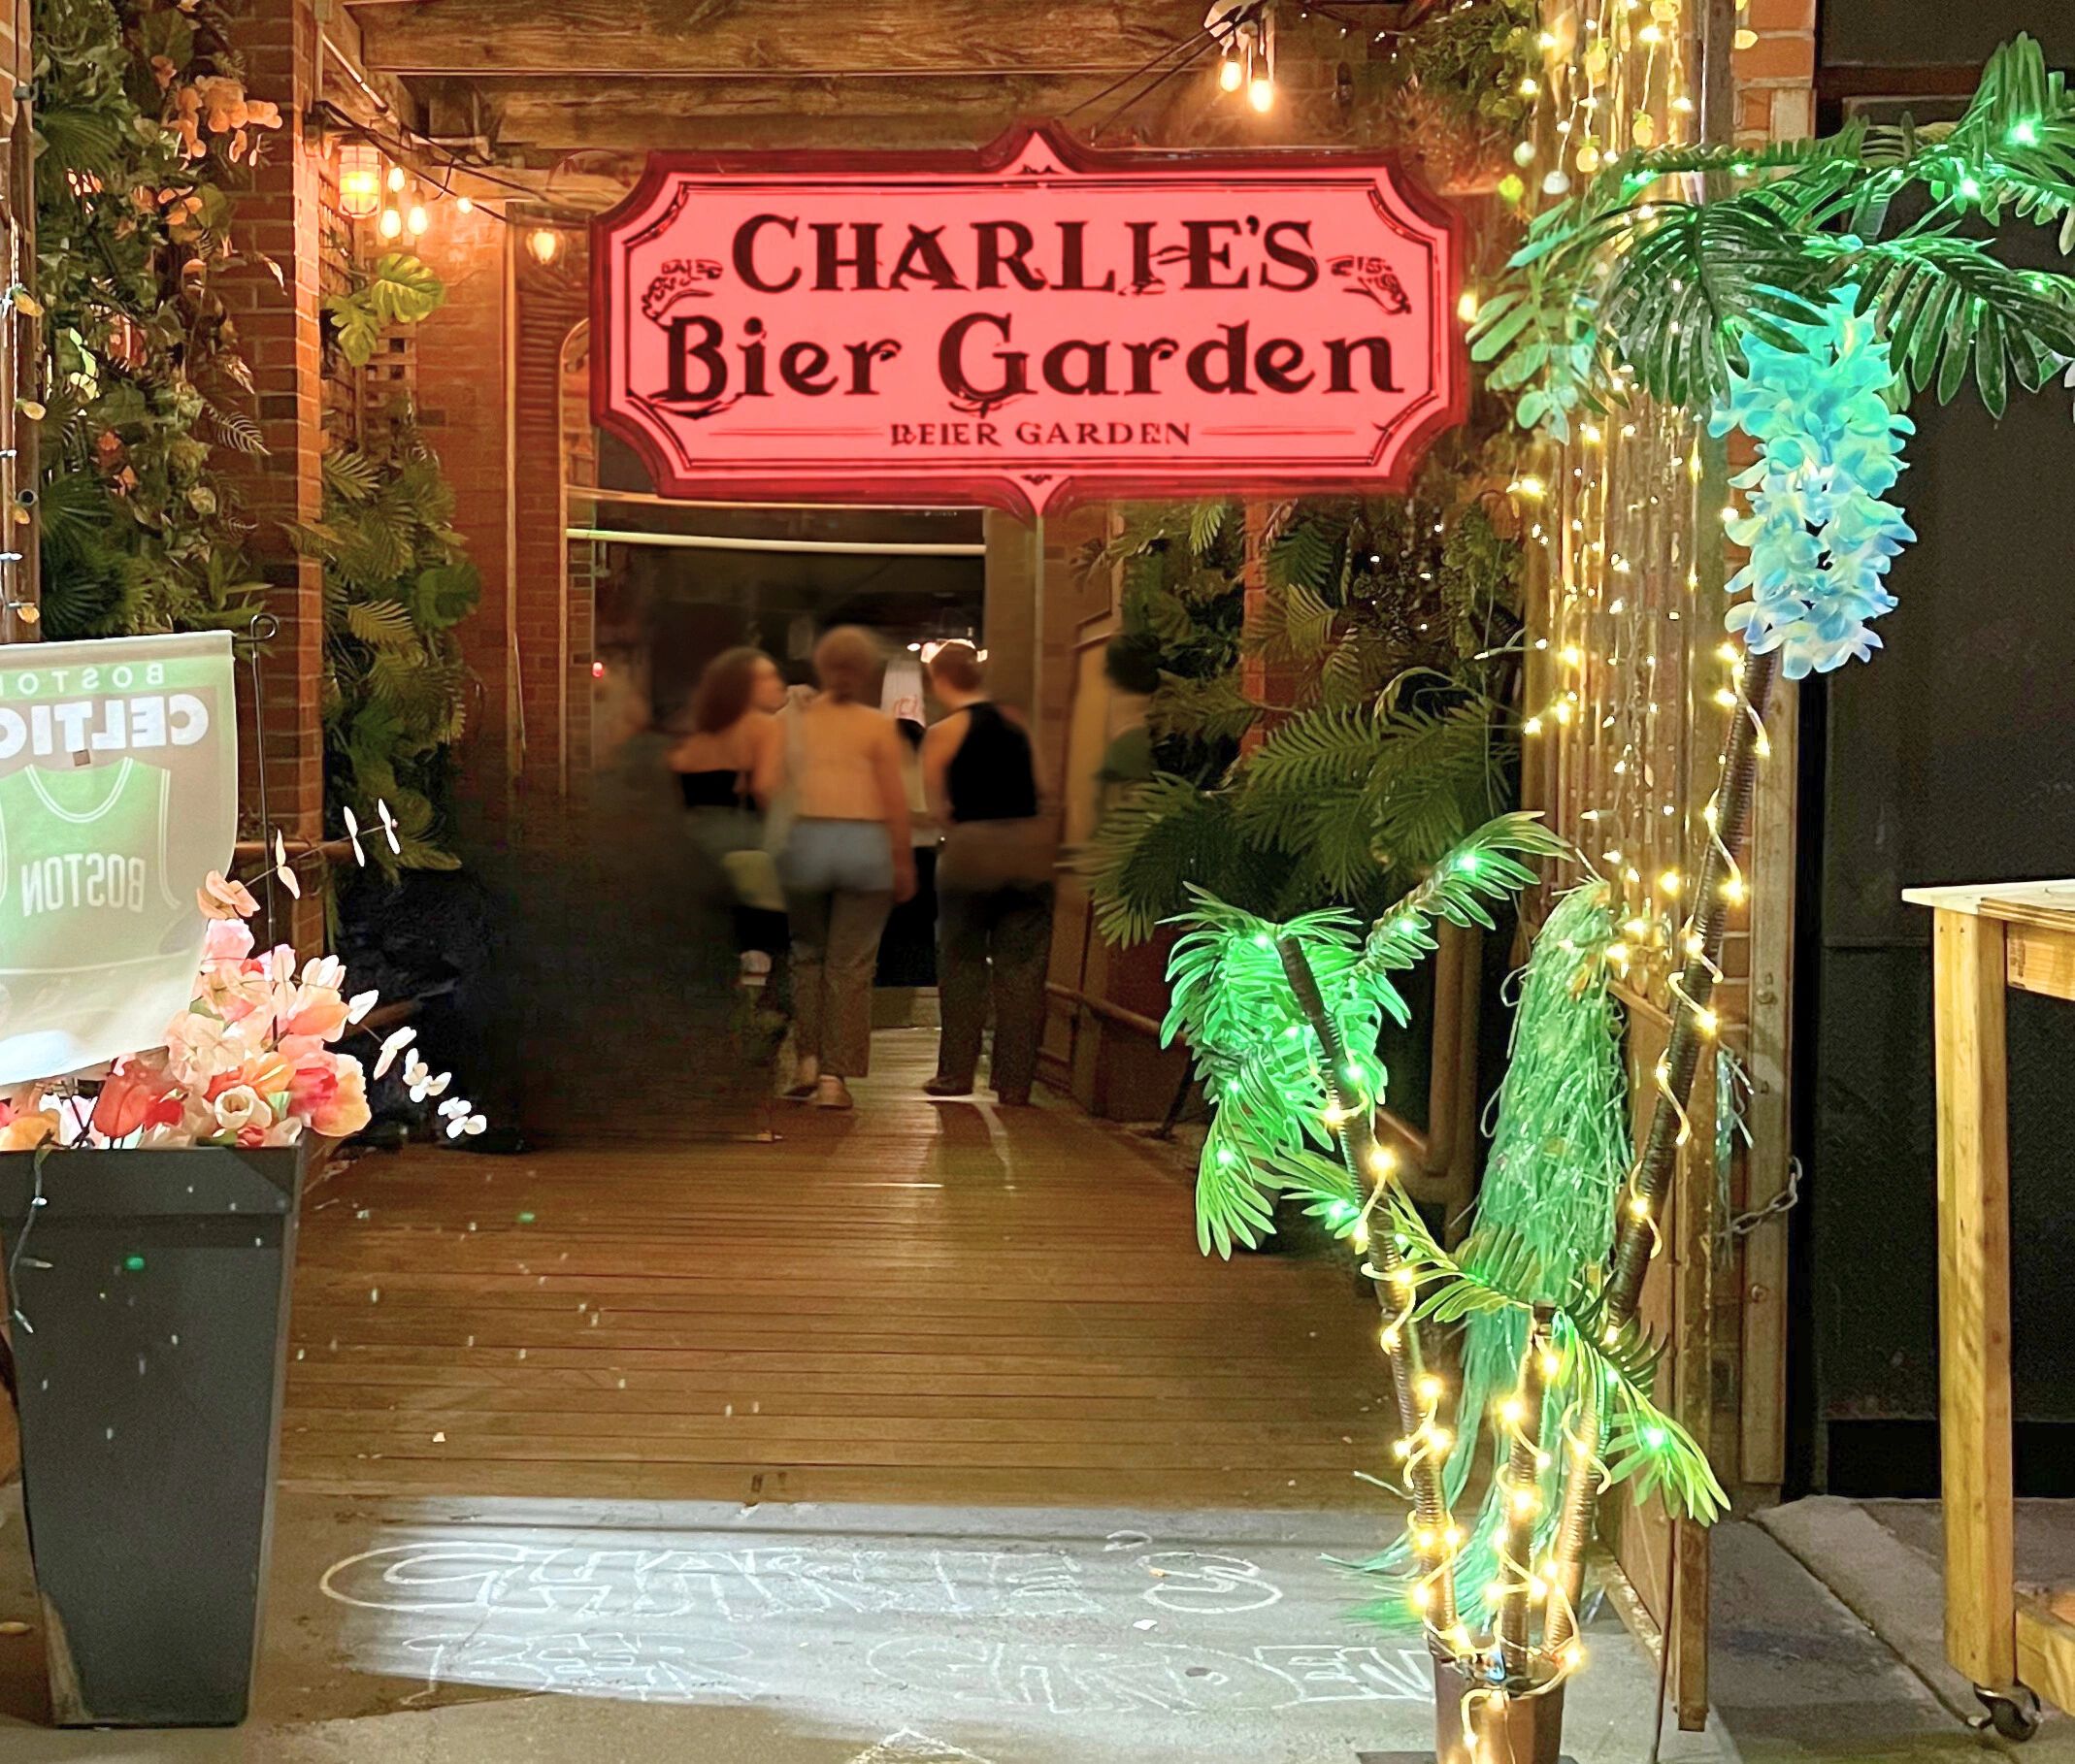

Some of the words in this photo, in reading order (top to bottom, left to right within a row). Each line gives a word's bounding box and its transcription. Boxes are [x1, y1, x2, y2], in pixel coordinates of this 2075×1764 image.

[733, 213, 1320, 294] CHARLIE'S
[647, 314, 903, 405] Bier
[938, 312, 1405, 405] Garden
[1015, 421, 1190, 445] GARDEN
